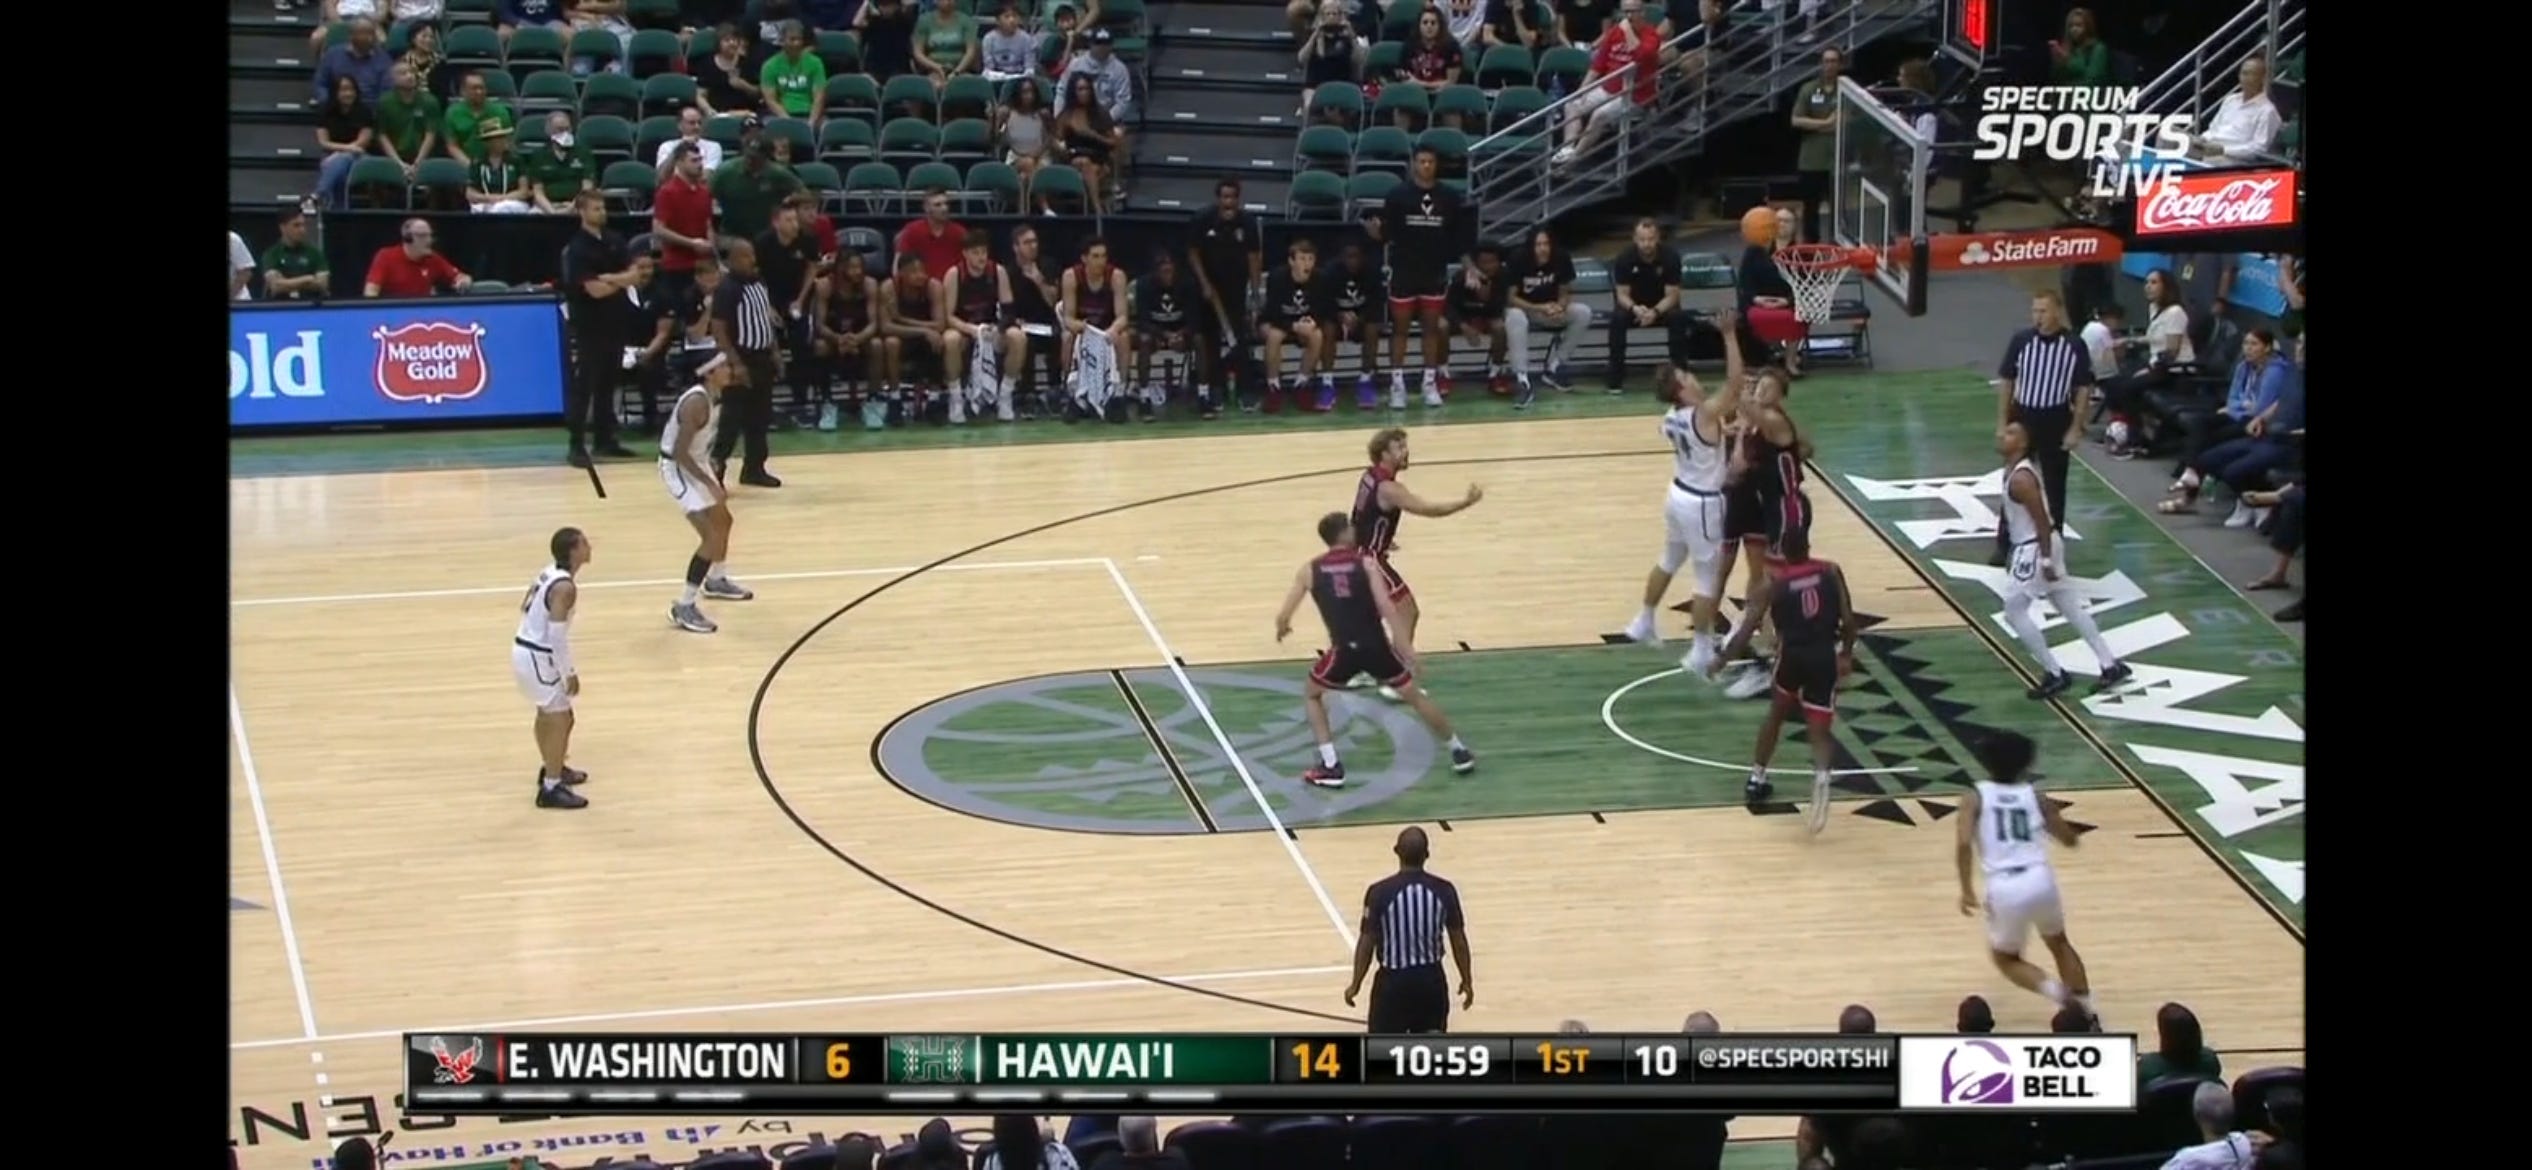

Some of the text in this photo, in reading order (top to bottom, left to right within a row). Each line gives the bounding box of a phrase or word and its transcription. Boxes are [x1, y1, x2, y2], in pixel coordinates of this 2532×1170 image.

[387, 341, 473, 362] Meadow
[407, 361, 458, 381] Gold
[1844, 466, 2304, 904] HAWA
[1993, 806, 2030, 842] 10
